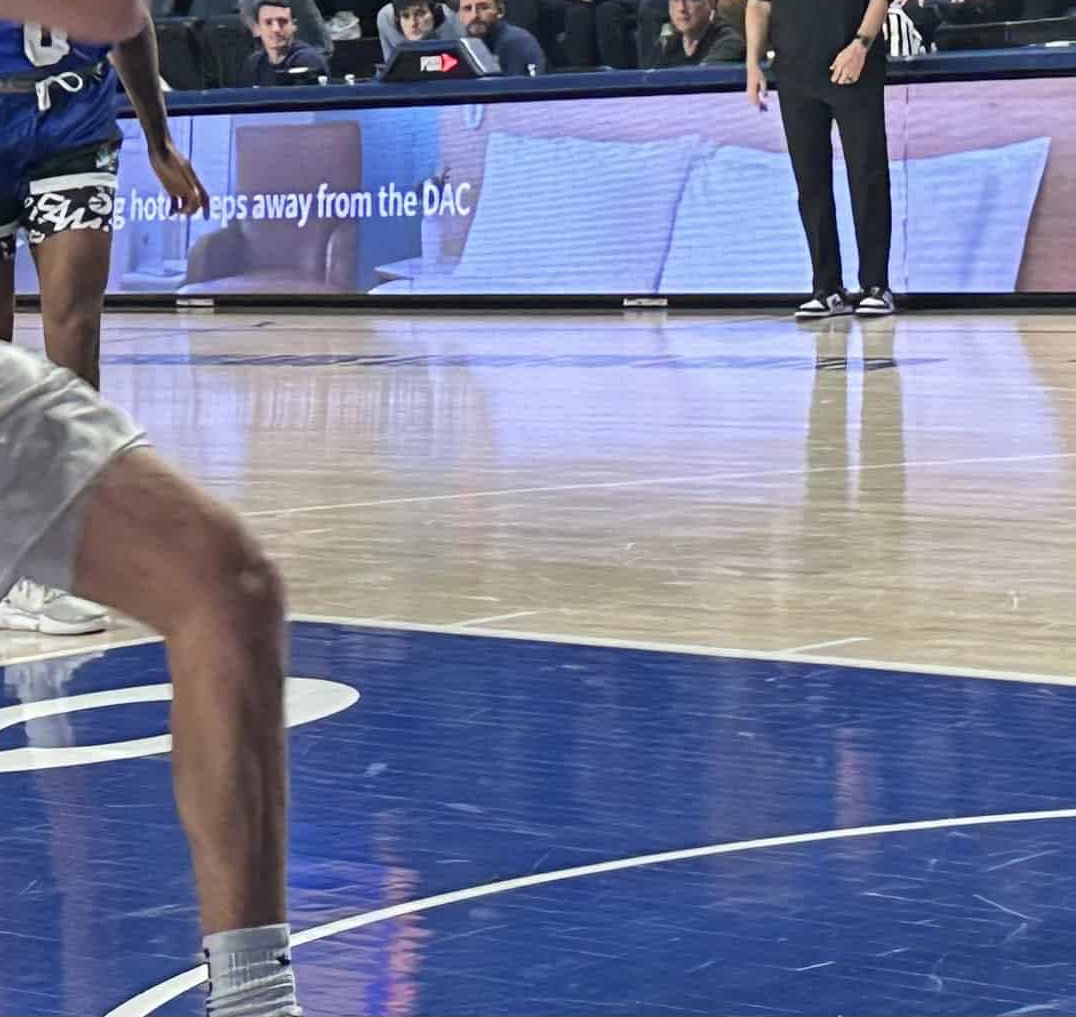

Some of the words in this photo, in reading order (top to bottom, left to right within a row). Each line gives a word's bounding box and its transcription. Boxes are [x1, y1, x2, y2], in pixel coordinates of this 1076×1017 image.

[252, 192, 313, 229] away
[317, 182, 372, 219] from
[377, 181, 418, 217] the
[422, 179, 471, 217] DAC
